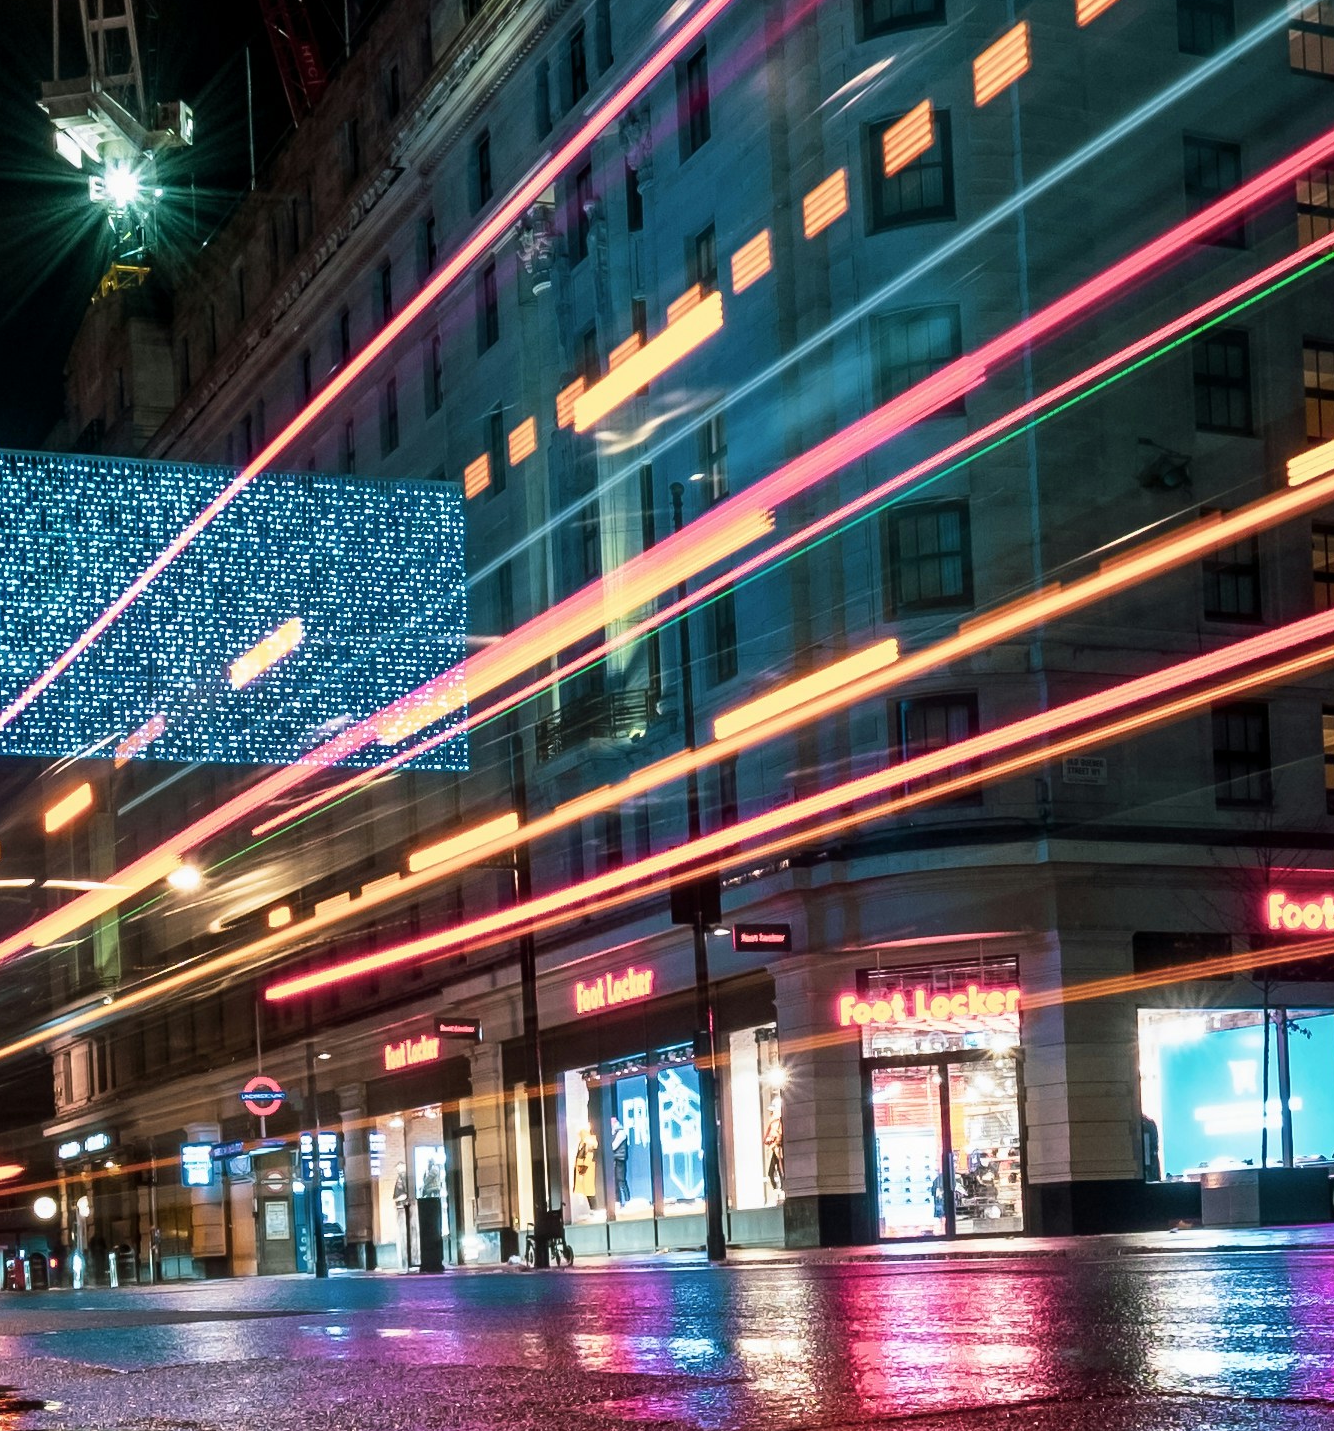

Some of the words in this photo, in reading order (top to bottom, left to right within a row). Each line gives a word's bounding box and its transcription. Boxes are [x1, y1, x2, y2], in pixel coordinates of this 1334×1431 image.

[575, 980, 605, 1014] Foot
[606, 967, 652, 1004] Locker
[840, 993, 906, 1026] Foot
[915, 984, 1021, 1019] Locker
